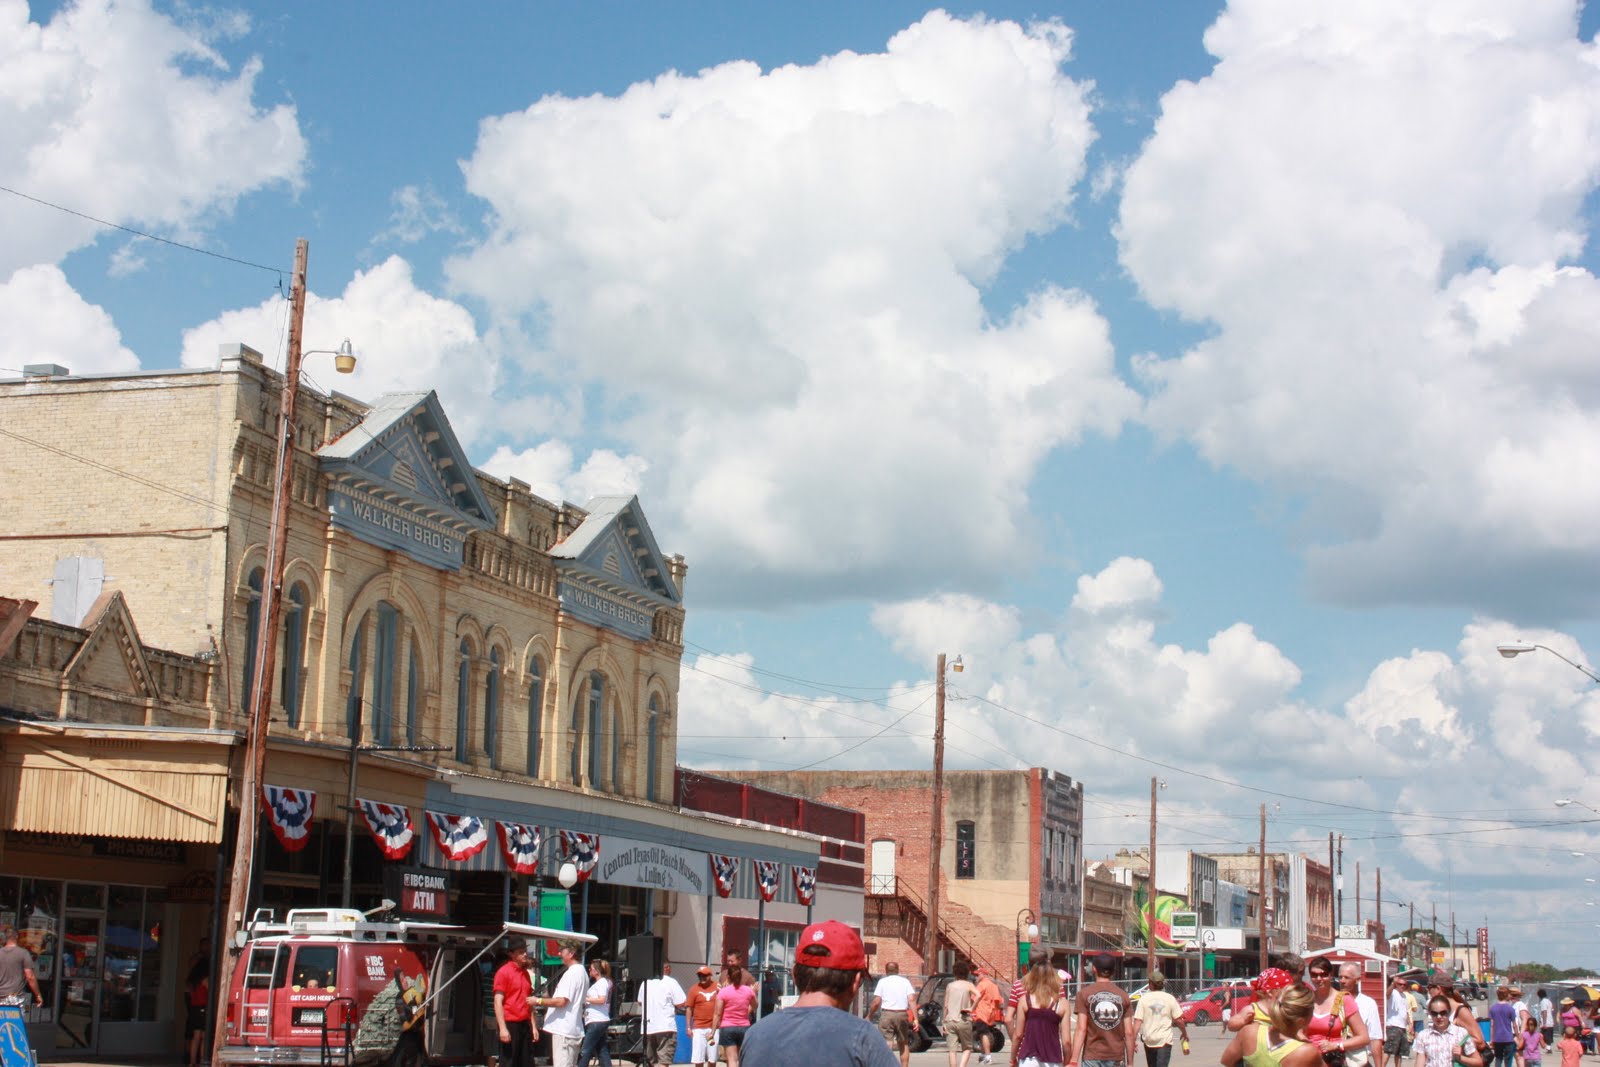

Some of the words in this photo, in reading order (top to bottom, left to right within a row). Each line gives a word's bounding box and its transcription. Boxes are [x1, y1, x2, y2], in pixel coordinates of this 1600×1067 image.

[352, 500, 410, 537] WALKER
[414, 526, 452, 553] BRO'S
[575, 589, 616, 617] WALKER
[618, 606, 645, 627] BRO'S
[107, 840, 179, 858] PHARMACY
[603, 848, 632, 880] Central
[633, 847, 650, 866] Texas
[651, 847, 660, 864] Oil
[660, 849, 678, 871] Patch
[678, 856, 703, 893] Museum
[644, 866, 667, 888] Luling
[410, 874, 424, 887] IBC
[424, 875, 446, 890] BANK
[413, 891, 435, 911] ATM
[367, 966, 386, 976] BANK
[370, 955, 384, 967] IBC
